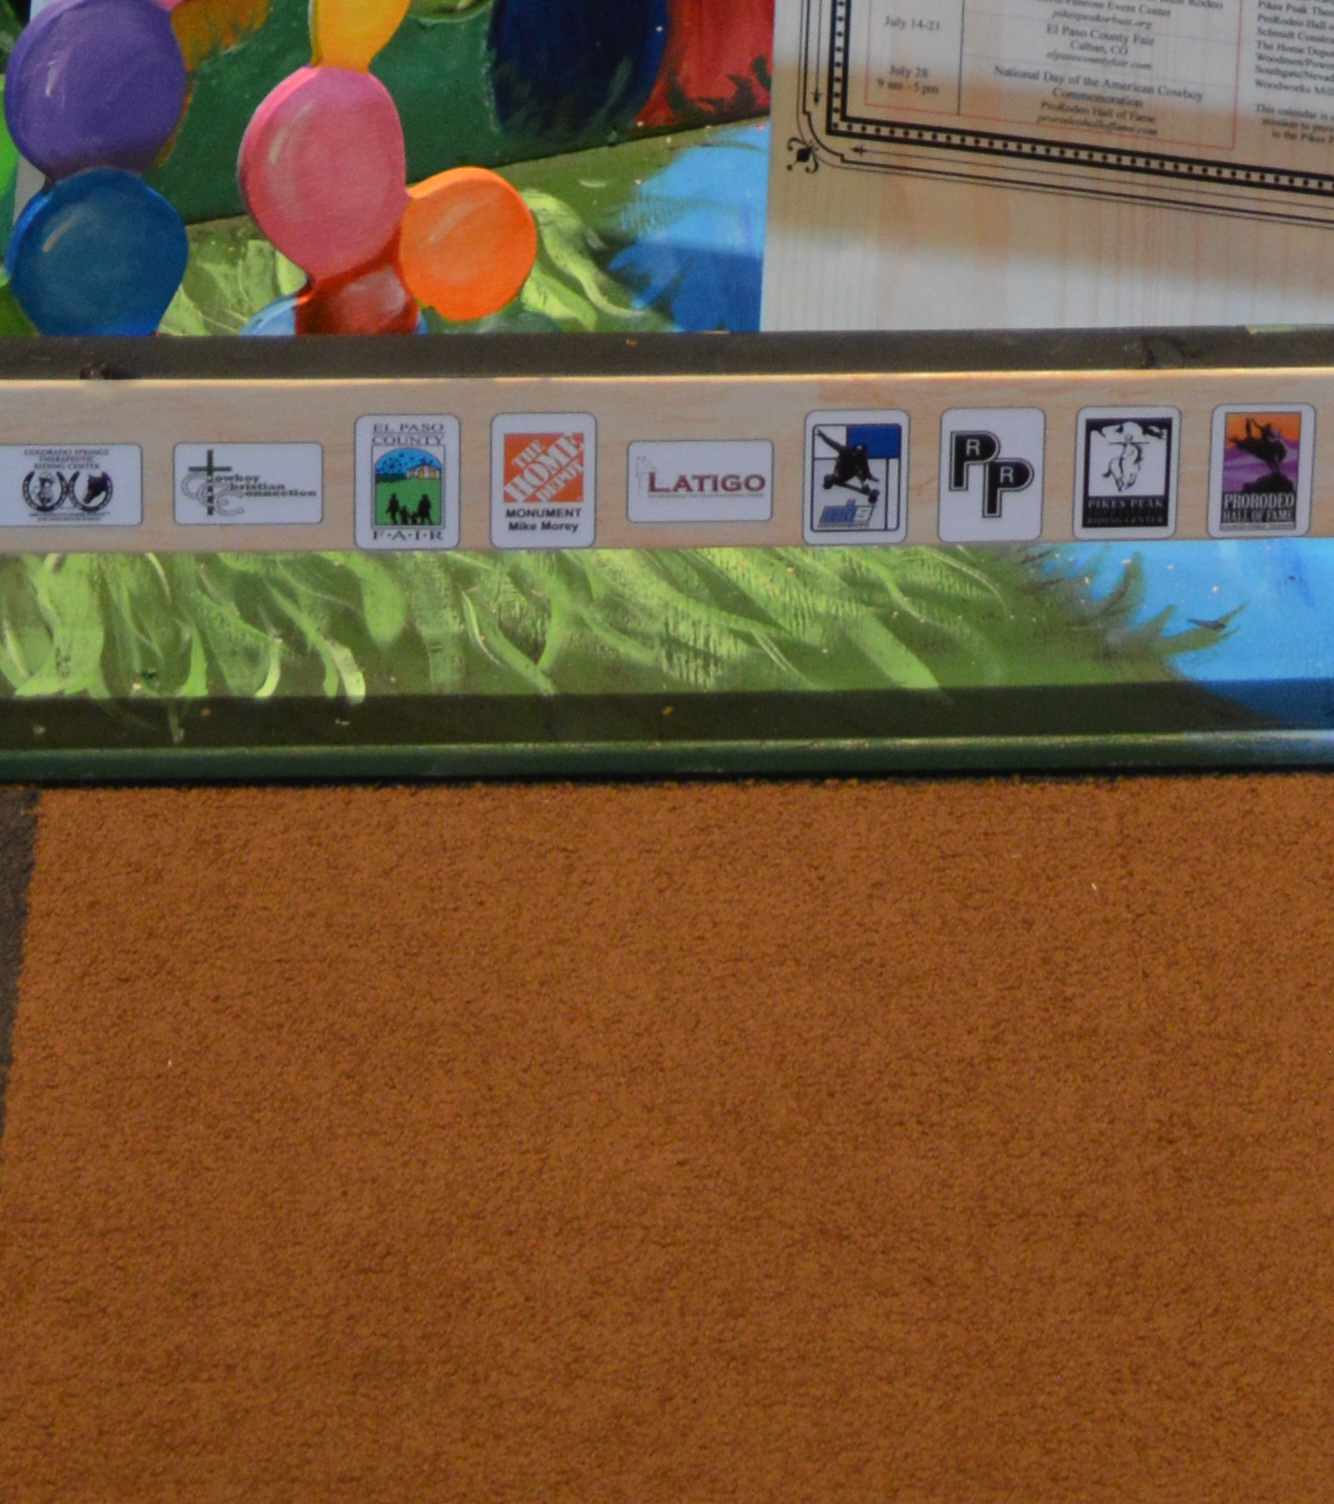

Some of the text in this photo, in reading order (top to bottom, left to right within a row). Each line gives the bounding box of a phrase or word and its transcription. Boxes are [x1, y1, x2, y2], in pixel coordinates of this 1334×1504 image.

[373, 423, 444, 433] EL PASO
[372, 435, 444, 446] COUNTY
[511, 439, 547, 470] THE
[504, 432, 584, 502] HOME
[647, 471, 766, 494] LATIGO
[1224, 493, 1295, 509] PRORODEO
[505, 508, 582, 518] MONUMENT
[508, 521, 538, 532] Mike
